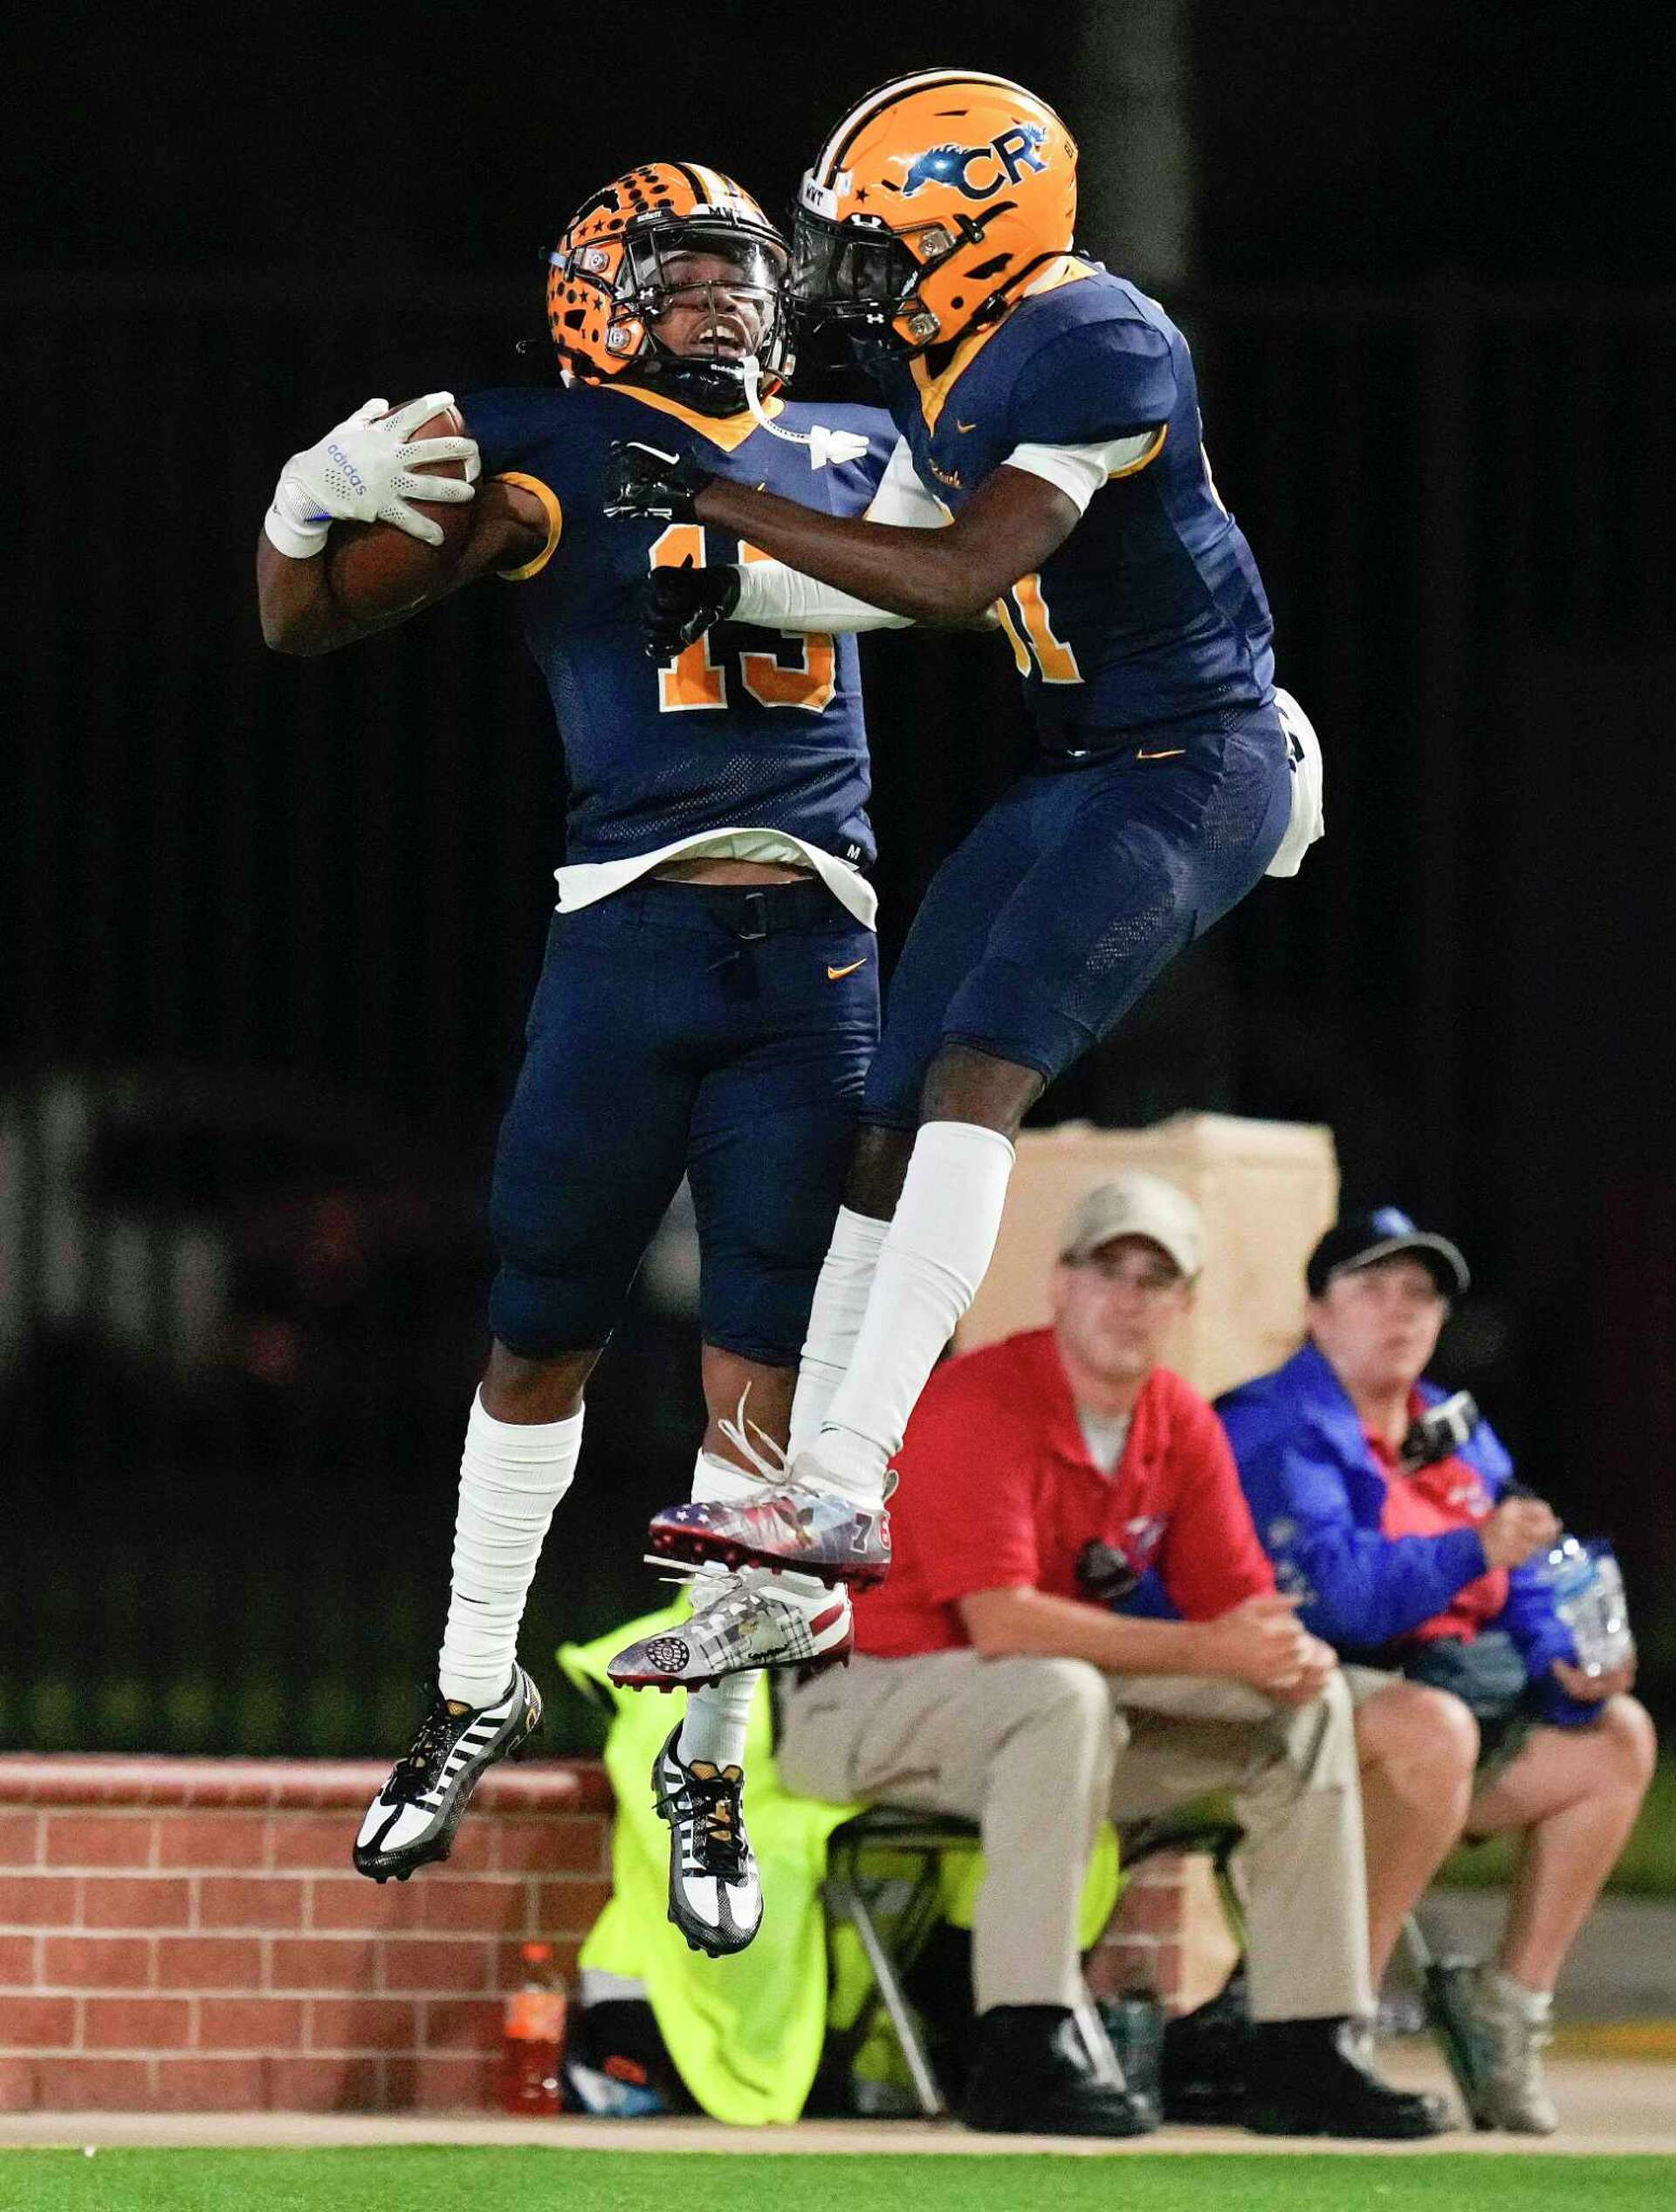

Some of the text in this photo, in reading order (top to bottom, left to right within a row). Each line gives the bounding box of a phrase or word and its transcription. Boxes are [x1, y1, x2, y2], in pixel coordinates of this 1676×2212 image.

[958, 127, 1048, 201] CR
[327, 443, 367, 497] adidas
[846, 843, 862, 860] M
[849, 1509, 875, 1554] 7
